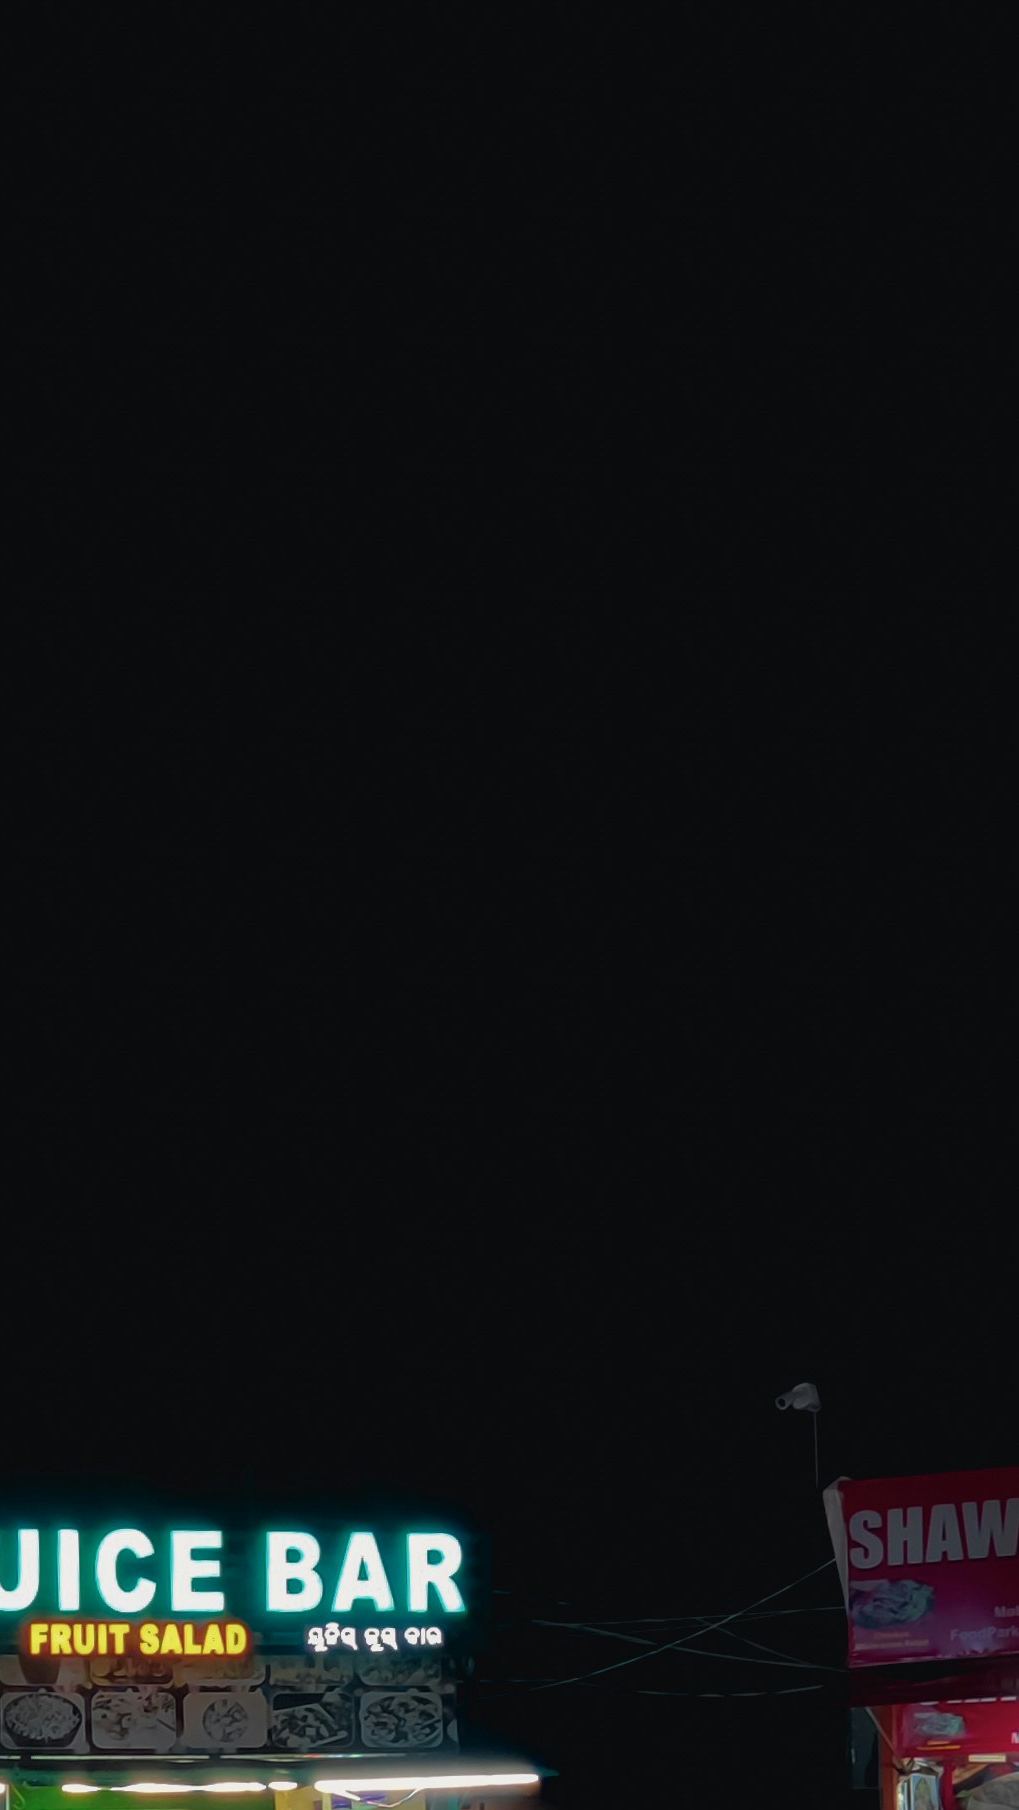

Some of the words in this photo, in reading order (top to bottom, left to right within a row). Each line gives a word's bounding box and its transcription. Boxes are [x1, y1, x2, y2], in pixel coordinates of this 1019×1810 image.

[265, 1531, 466, 1613] BAR
[29, 1623, 131, 1655] FRUIT
[139, 1623, 248, 1655] SALAD
